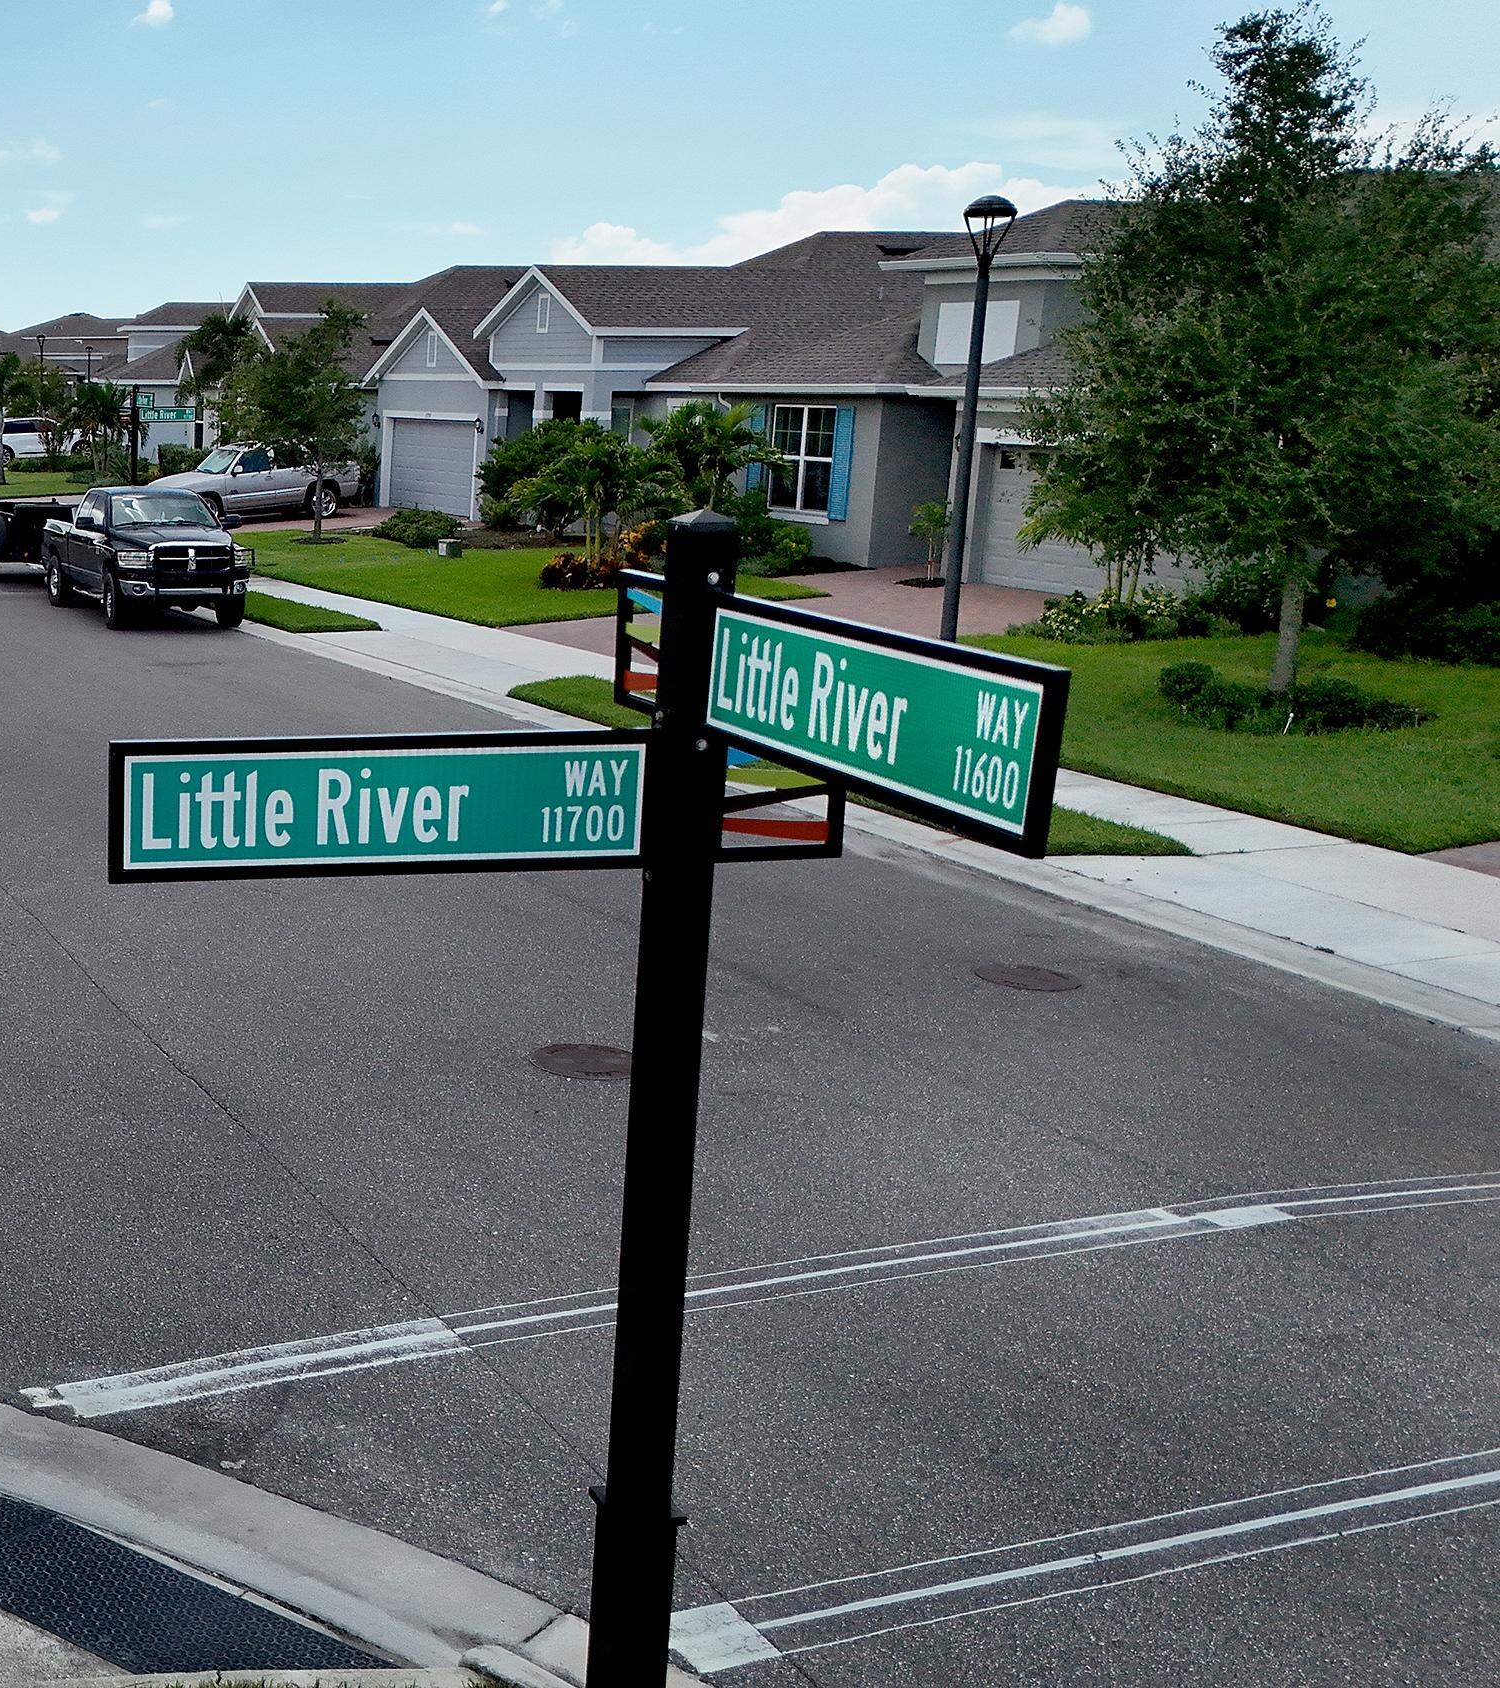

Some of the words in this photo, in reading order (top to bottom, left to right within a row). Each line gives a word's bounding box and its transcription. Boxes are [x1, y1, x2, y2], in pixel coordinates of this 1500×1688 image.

[141, 409, 158, 420] Little
[159, 409, 177, 420] River
[717, 627, 799, 731] Little
[807, 650, 908, 766] River
[976, 689, 1029, 750] WAY
[564, 759, 628, 798] WAY
[952, 745, 1020, 810] 11600
[142, 769, 294, 850] Little
[316, 767, 470, 846] River
[541, 804, 625, 843] 11700
